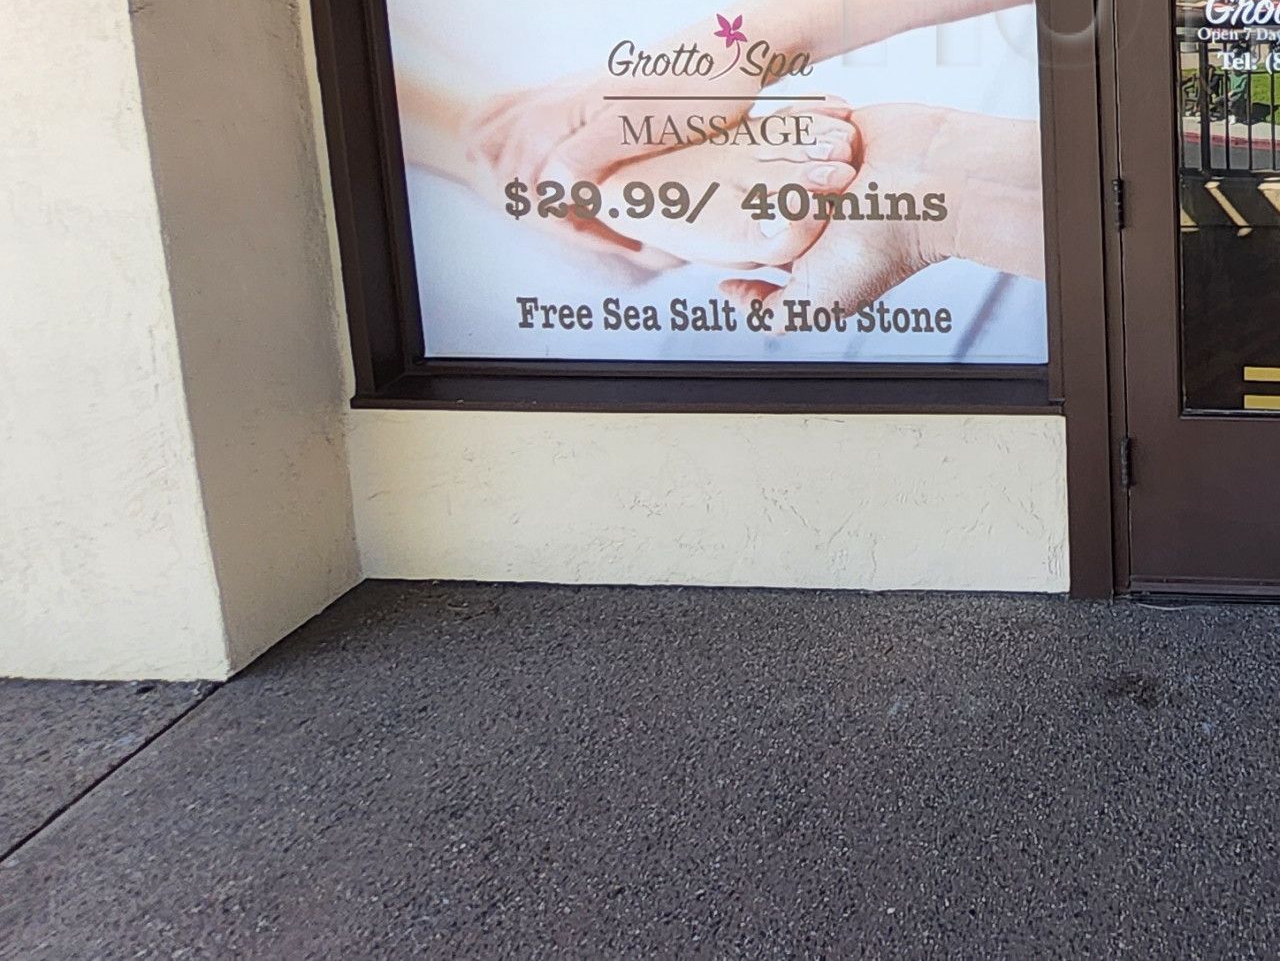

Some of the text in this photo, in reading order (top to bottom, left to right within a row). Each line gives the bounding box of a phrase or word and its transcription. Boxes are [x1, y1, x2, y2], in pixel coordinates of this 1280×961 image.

[1197, 27, 1239, 44] Open
[1243, 27, 1252, 41] 7
[607, 40, 814, 85] Grotto Spa
[1217, 52, 1257, 71] Tel:
[619, 115, 818, 147] MASSAGE
[503, 177, 948, 224] $29.99/ 40mins
[516, 297, 952, 335] Free Sea Salt & Hot Stone
